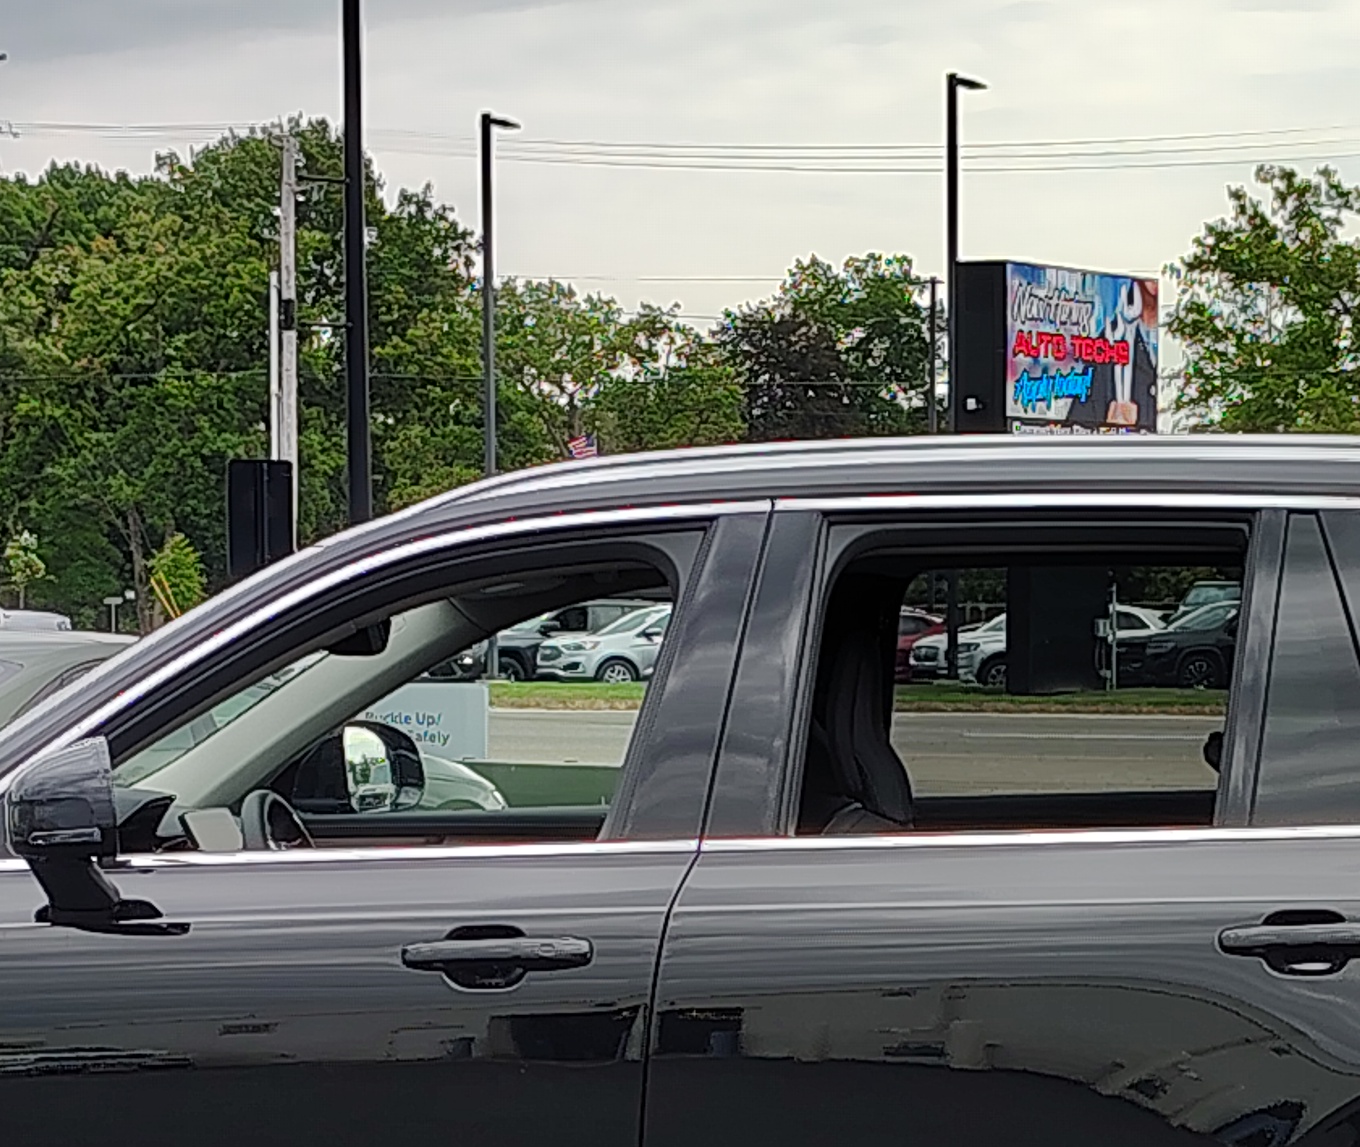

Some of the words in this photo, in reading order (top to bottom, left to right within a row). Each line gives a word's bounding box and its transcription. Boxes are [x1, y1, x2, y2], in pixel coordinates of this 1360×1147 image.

[1013, 331, 1066, 361] AUTO
[1071, 335, 1129, 365] TECHS
[365, 711, 412, 725] Bckle
[415, 711, 443, 727] Up!
[407, 729, 450, 746] afely
